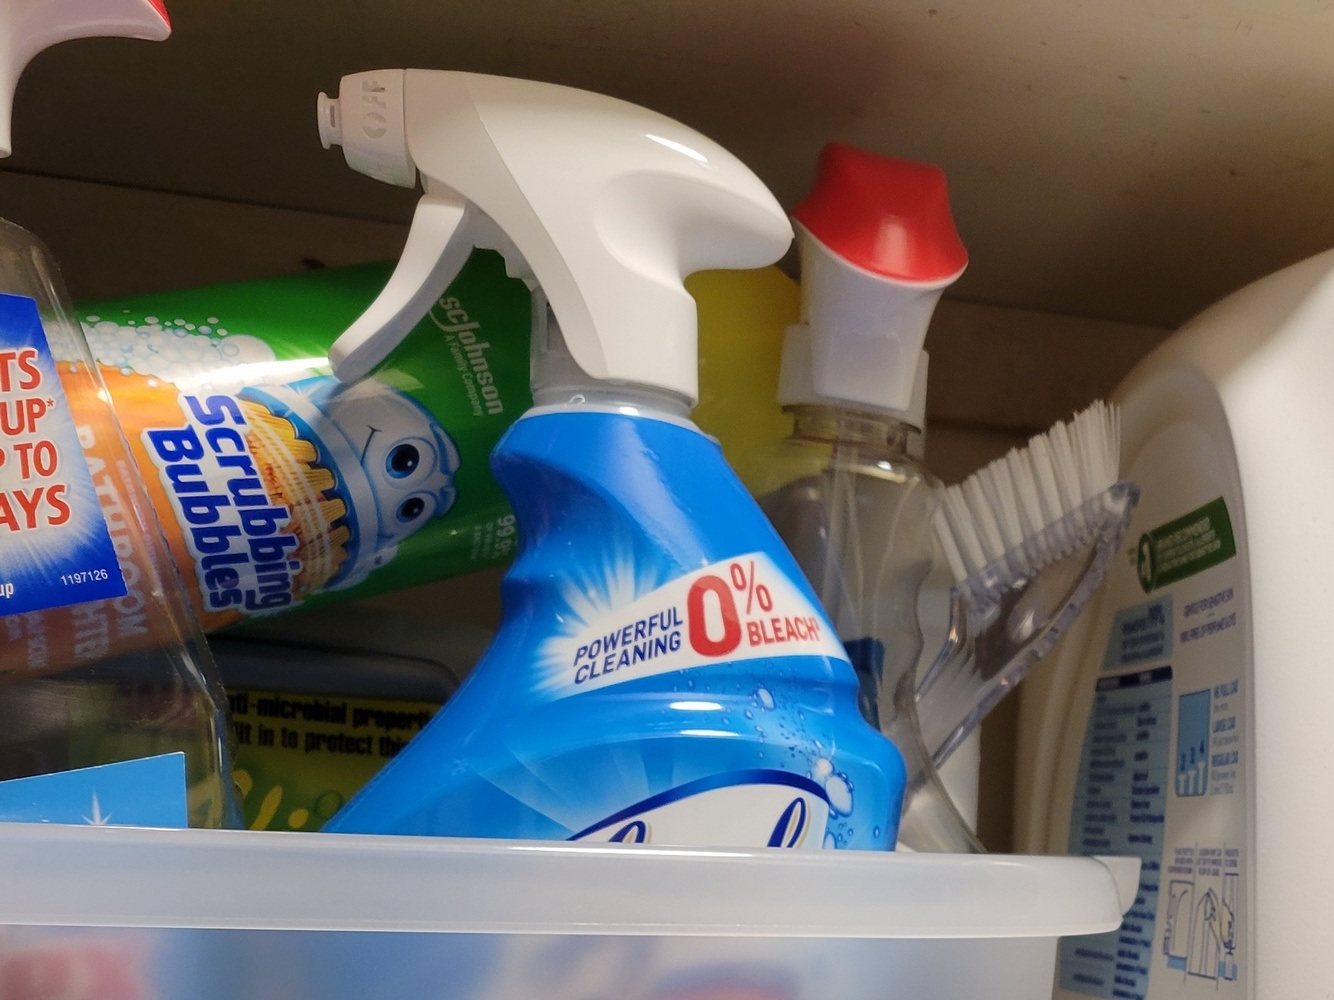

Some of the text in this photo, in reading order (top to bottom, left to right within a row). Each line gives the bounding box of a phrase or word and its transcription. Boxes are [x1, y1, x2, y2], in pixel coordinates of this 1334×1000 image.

[13, 440, 58, 480] TO
[147, 424, 250, 609] Bubbles
[183, 395, 302, 612] Scrubbing
[61, 568, 108, 587] 1197126
[573, 607, 684, 667] POWERFUL
[687, 560, 774, 658] 0%
[574, 631, 682, 685] CLEANING
[281, 727, 299, 750] to
[305, 731, 372, 757] protect
